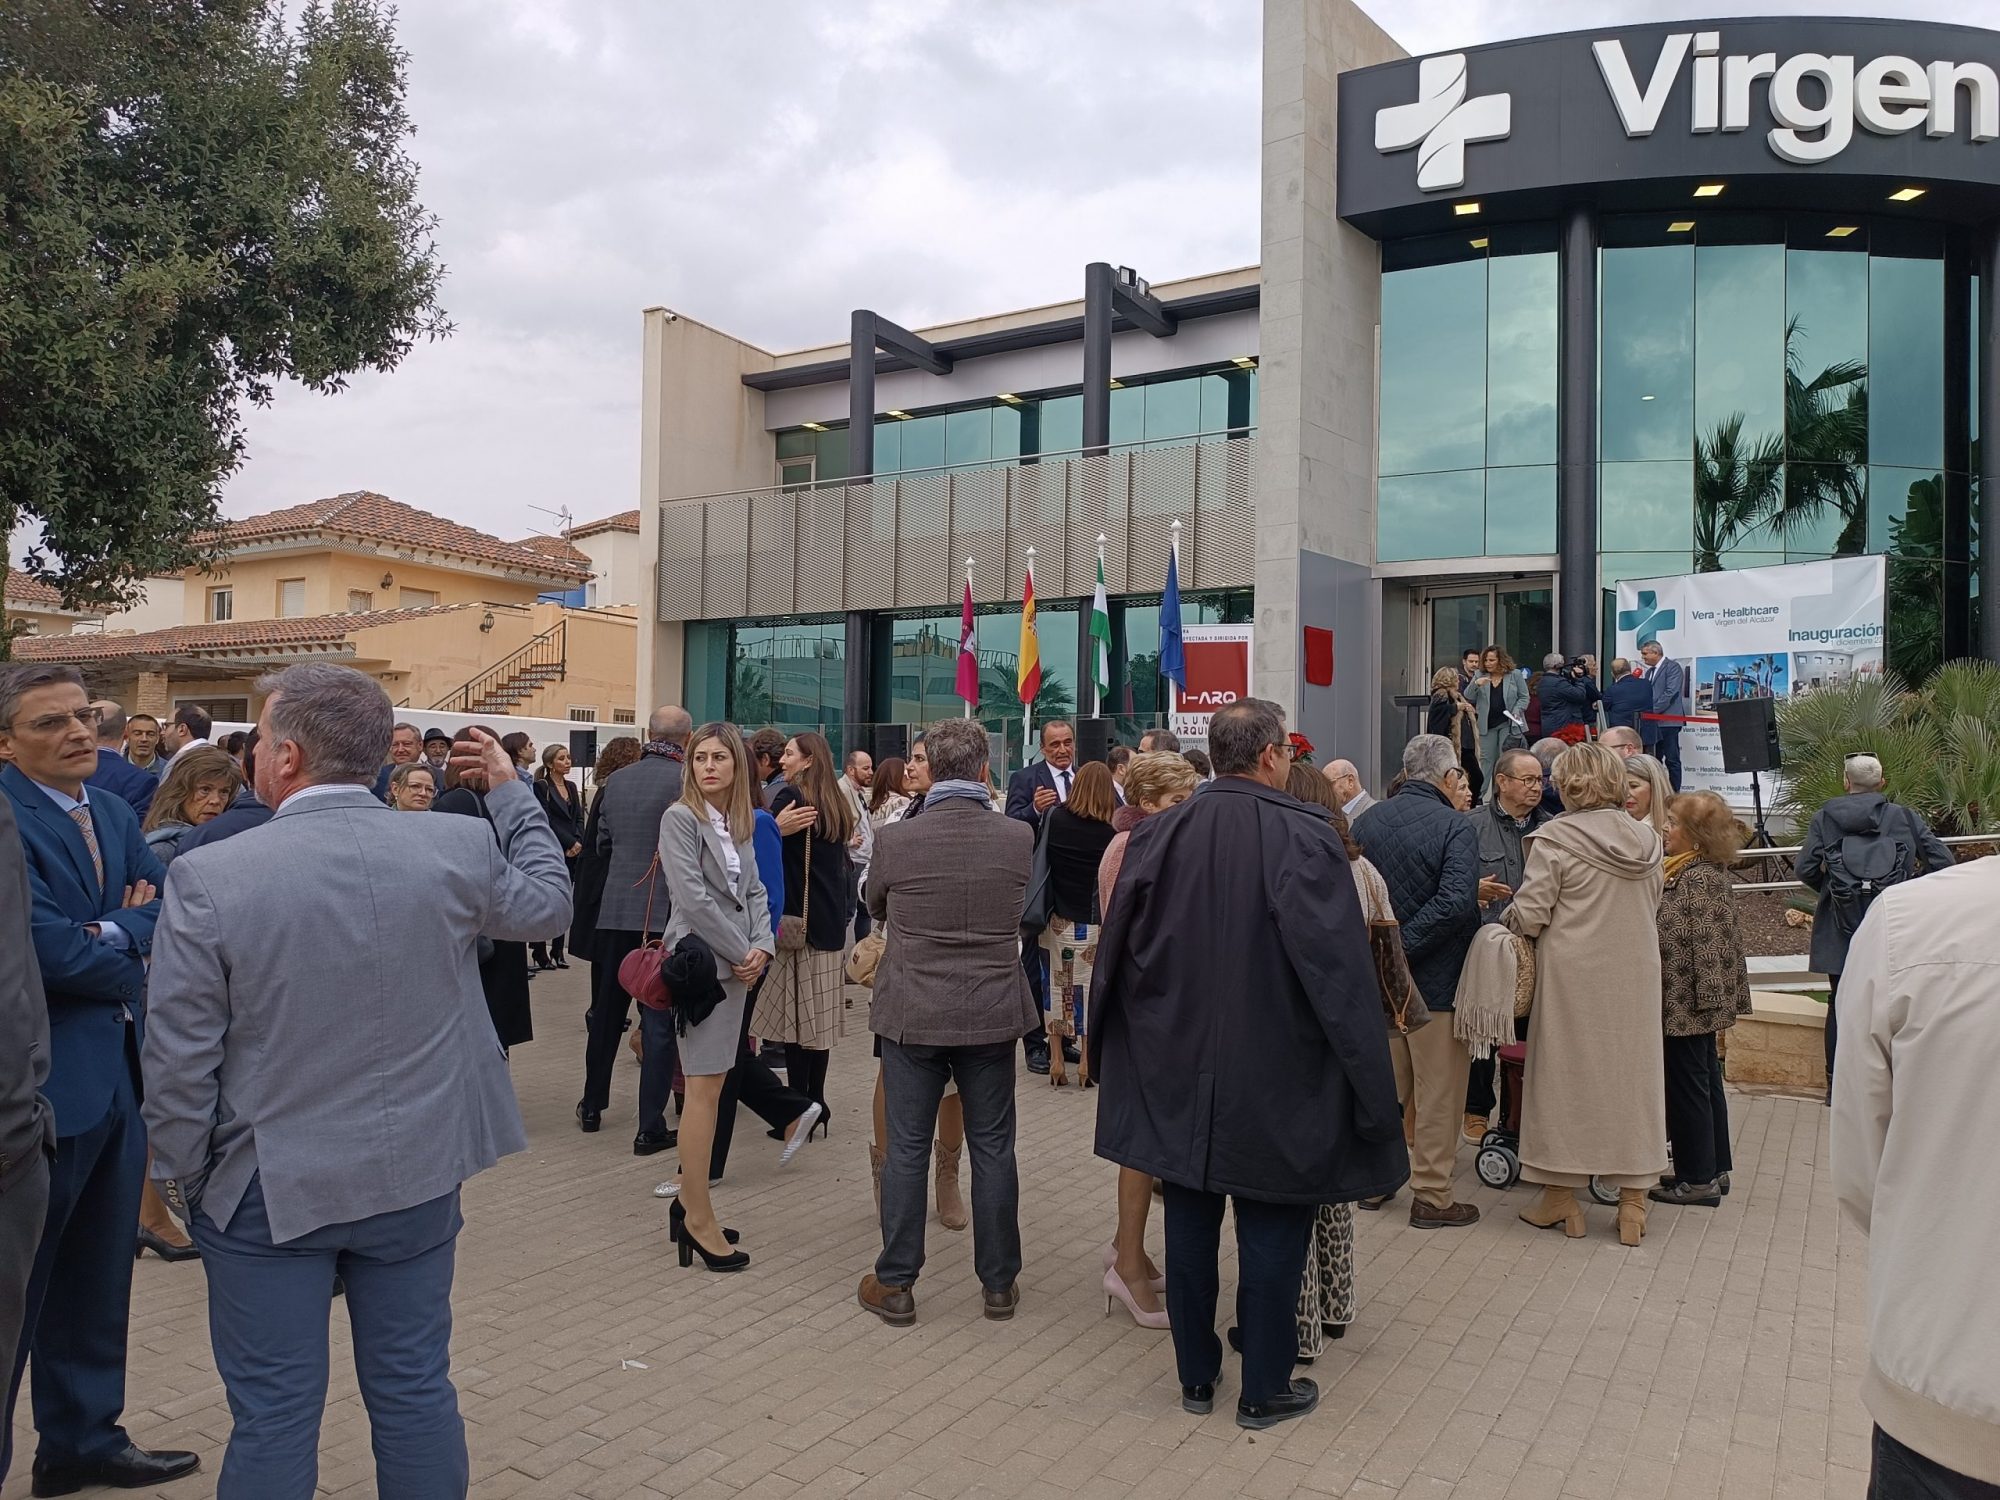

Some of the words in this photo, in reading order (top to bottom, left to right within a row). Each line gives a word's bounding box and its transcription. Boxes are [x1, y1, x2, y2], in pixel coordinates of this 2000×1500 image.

[1591, 31, 2000, 164] Virgen
[1691, 610, 1715, 620] Vera
[1722, 606, 1779, 618] Healthcare
[1788, 622, 1884, 644] Inauguración
[1175, 715, 1210, 725] ILUN
[1175, 726, 1208, 736] ARQUI
